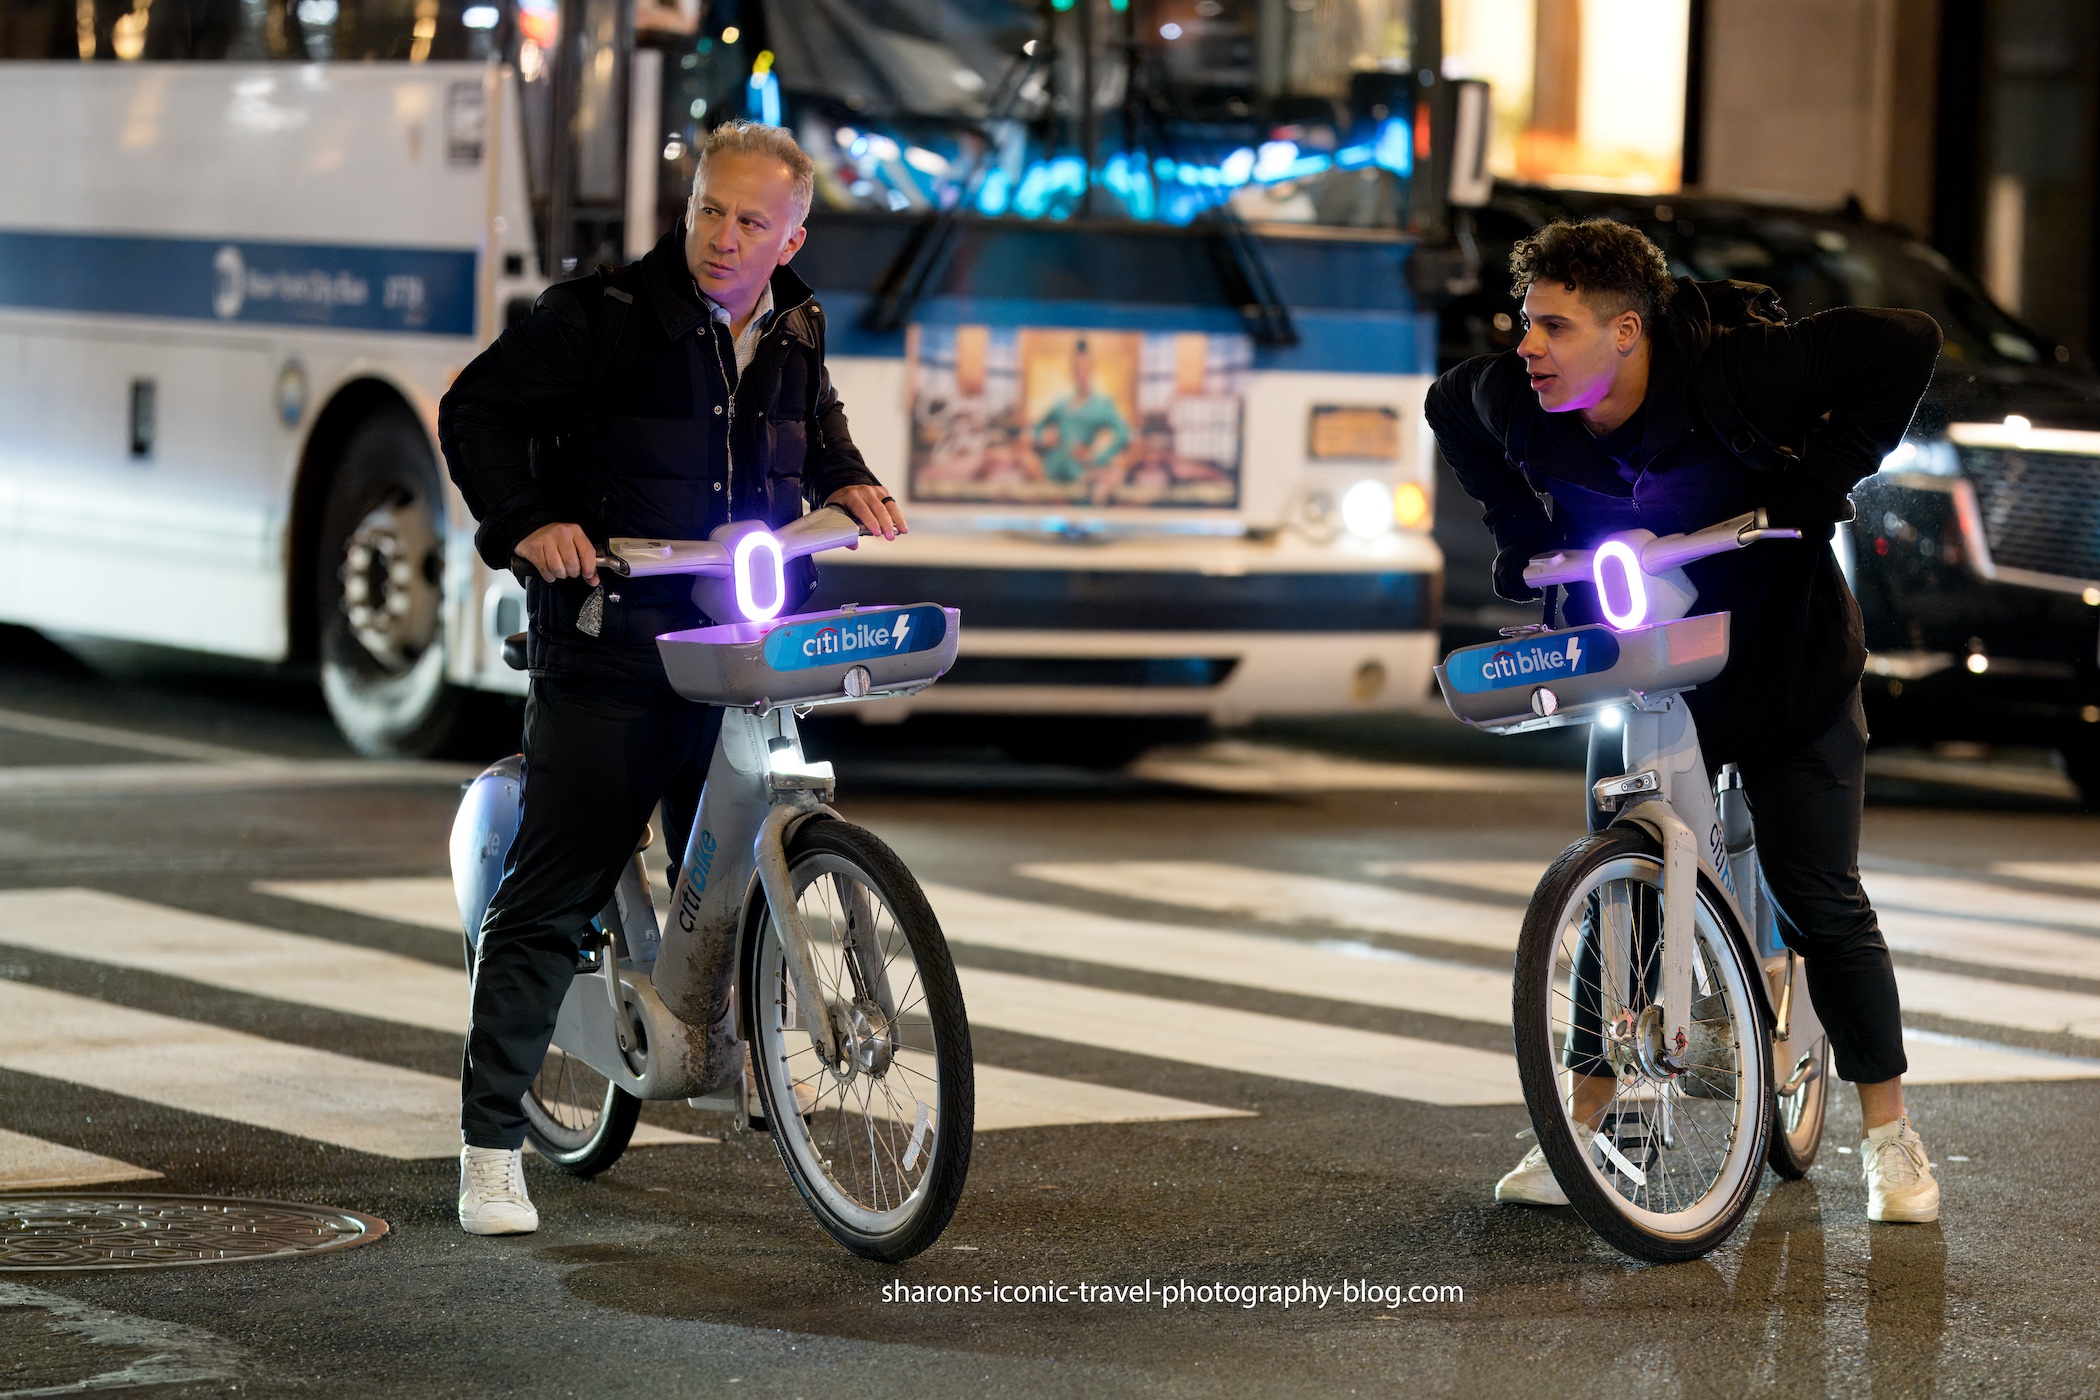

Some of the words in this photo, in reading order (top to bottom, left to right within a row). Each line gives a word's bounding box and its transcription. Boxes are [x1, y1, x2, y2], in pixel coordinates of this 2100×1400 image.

[803, 628, 839, 657] citi
[841, 624, 890, 651] bike
[1482, 652, 1518, 680] citi
[1516, 647, 1565, 674] bike
[679, 883, 702, 934] citi
